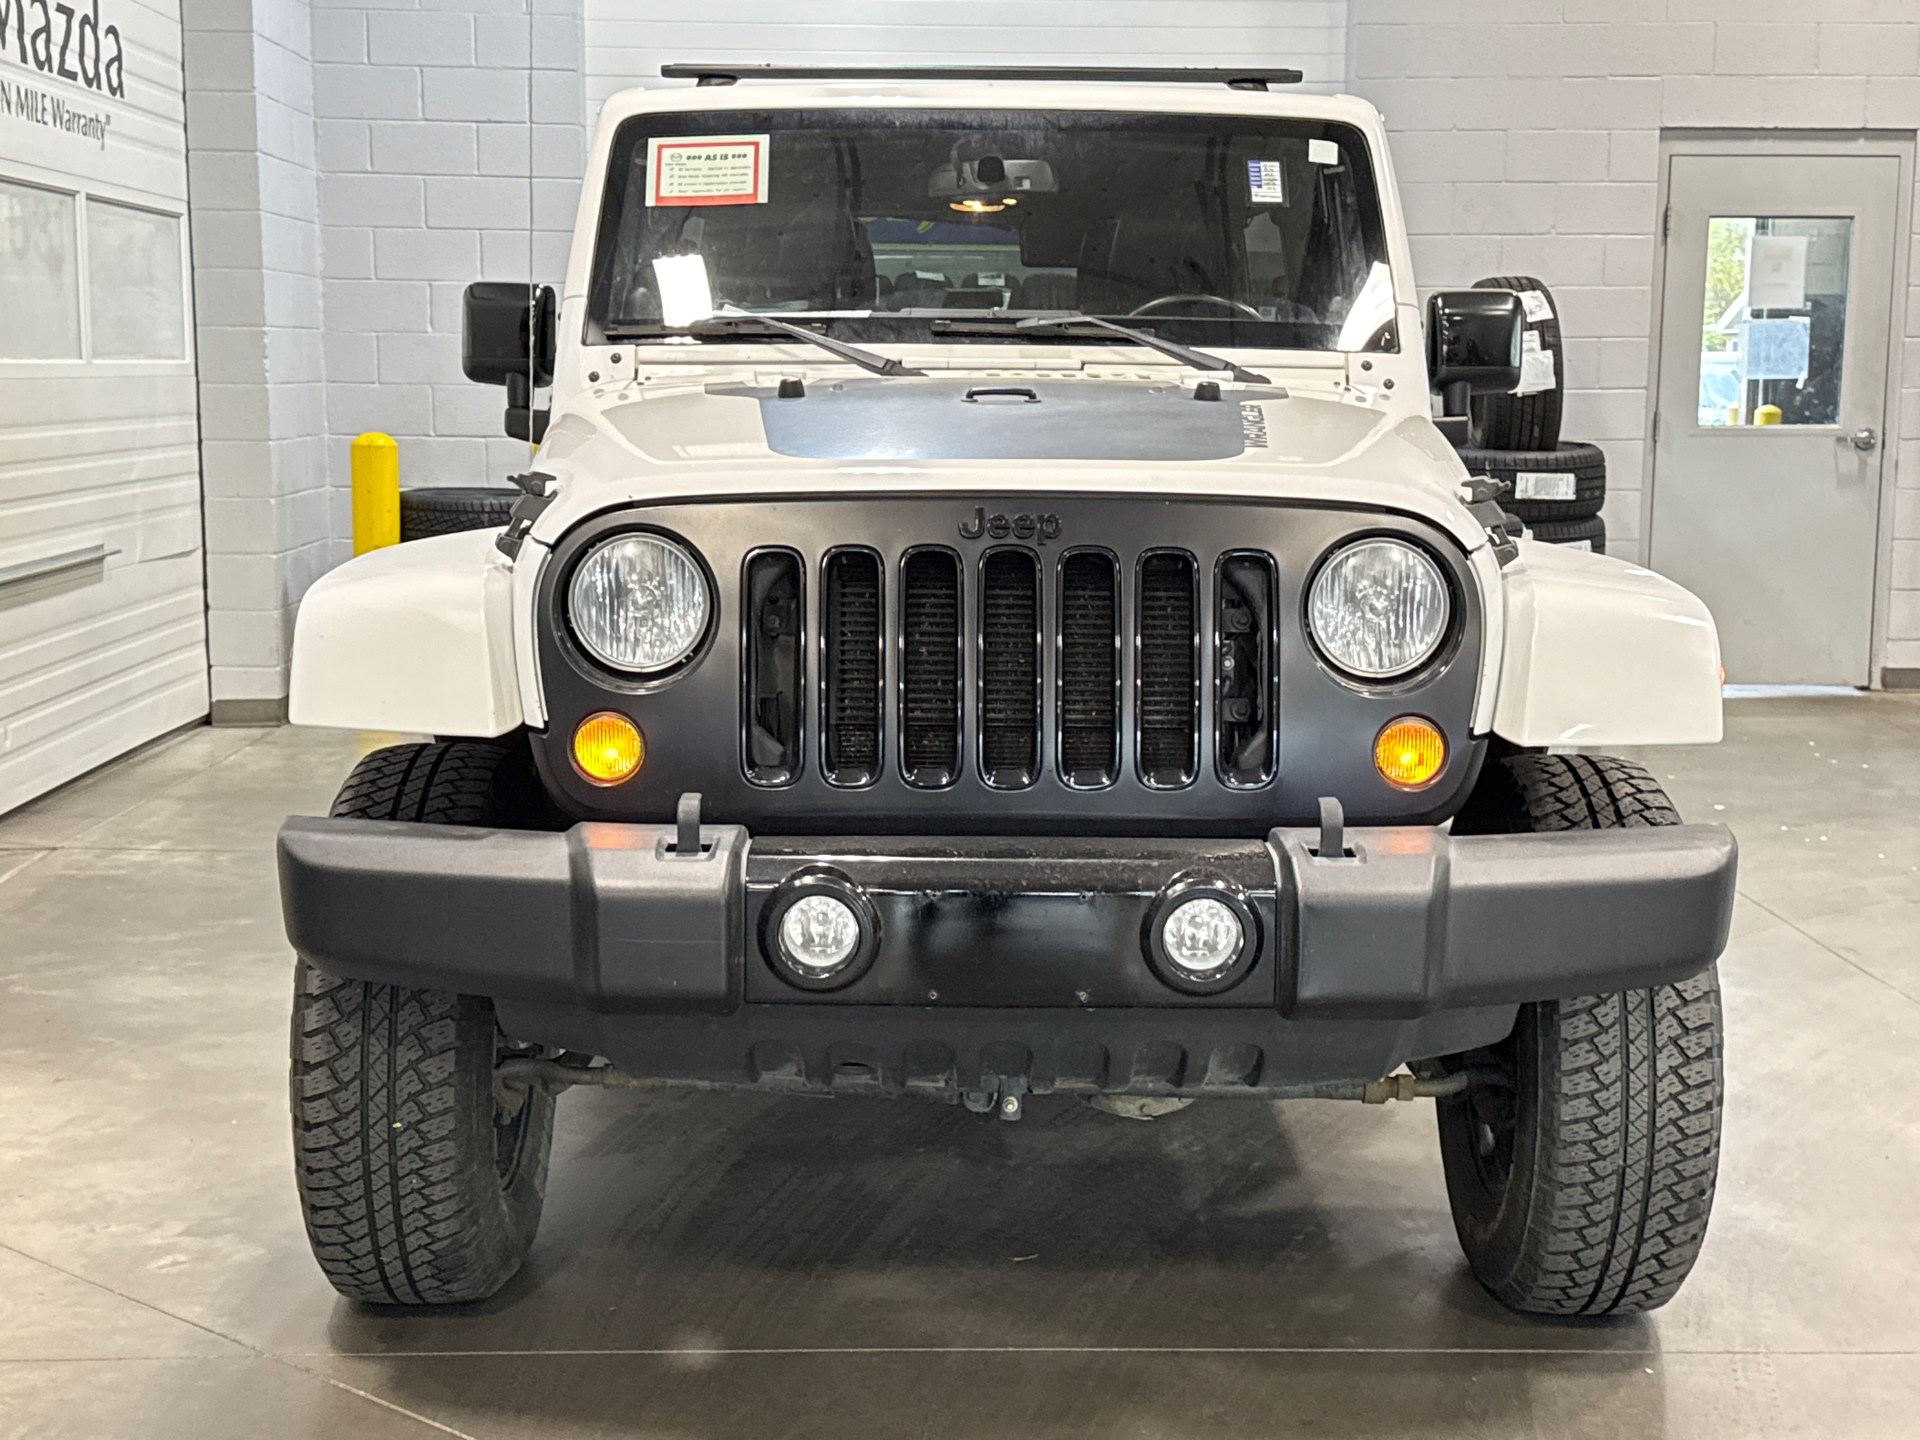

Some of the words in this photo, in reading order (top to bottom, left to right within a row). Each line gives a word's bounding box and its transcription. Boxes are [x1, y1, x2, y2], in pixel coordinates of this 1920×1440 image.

[15, 84, 48, 126] MILE
[719, 153, 729, 161] IS
[957, 505, 1062, 546] Jeep
